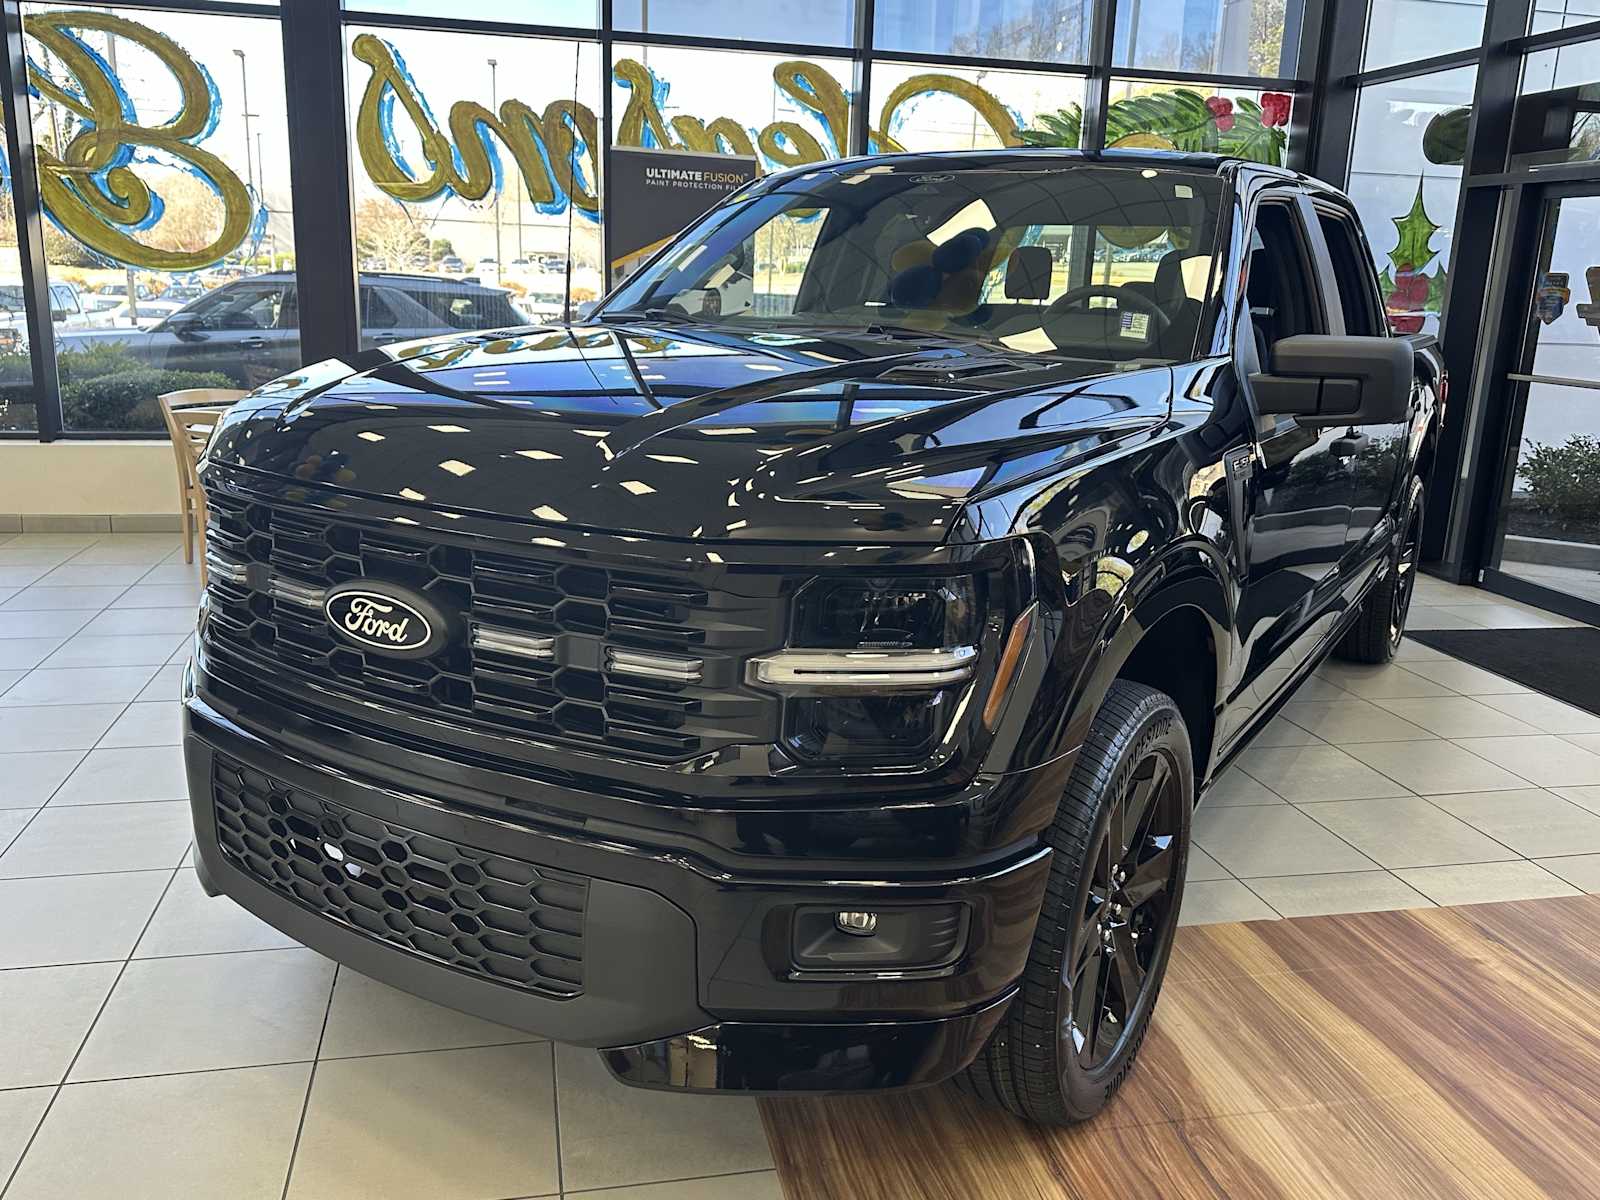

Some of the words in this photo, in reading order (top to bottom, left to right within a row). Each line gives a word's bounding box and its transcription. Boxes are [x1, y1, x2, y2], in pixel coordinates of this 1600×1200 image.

[646, 168, 702, 181] ULTIMATE
[703, 172, 744, 184] FUSION
[646, 179, 669, 187] PAINT
[672, 181, 723, 191] PROTECTION
[345, 598, 409, 642] Ford
